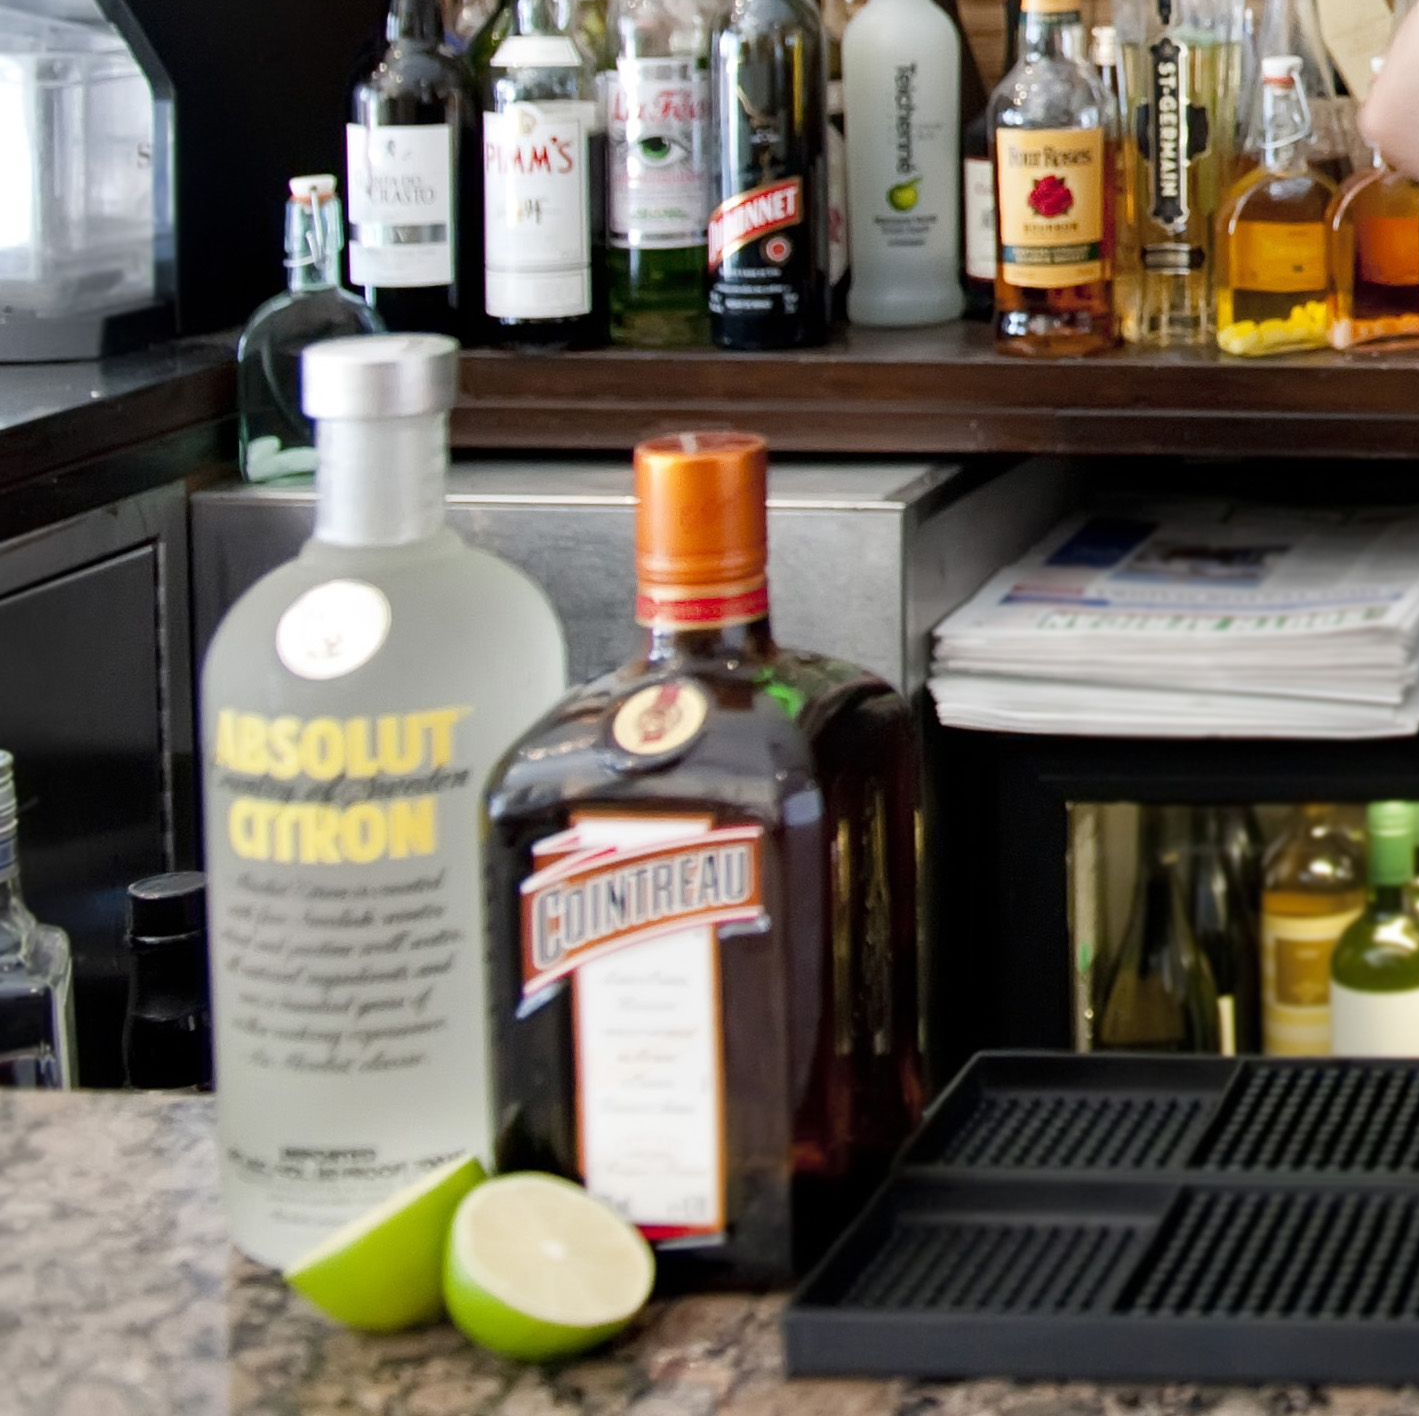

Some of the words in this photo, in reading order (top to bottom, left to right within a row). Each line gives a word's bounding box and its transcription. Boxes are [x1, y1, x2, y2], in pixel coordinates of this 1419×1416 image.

[214, 705, 475, 781] ABSOLUT
[228, 794, 438, 865] CITRON
[530, 844, 750, 971] COINTREAU
